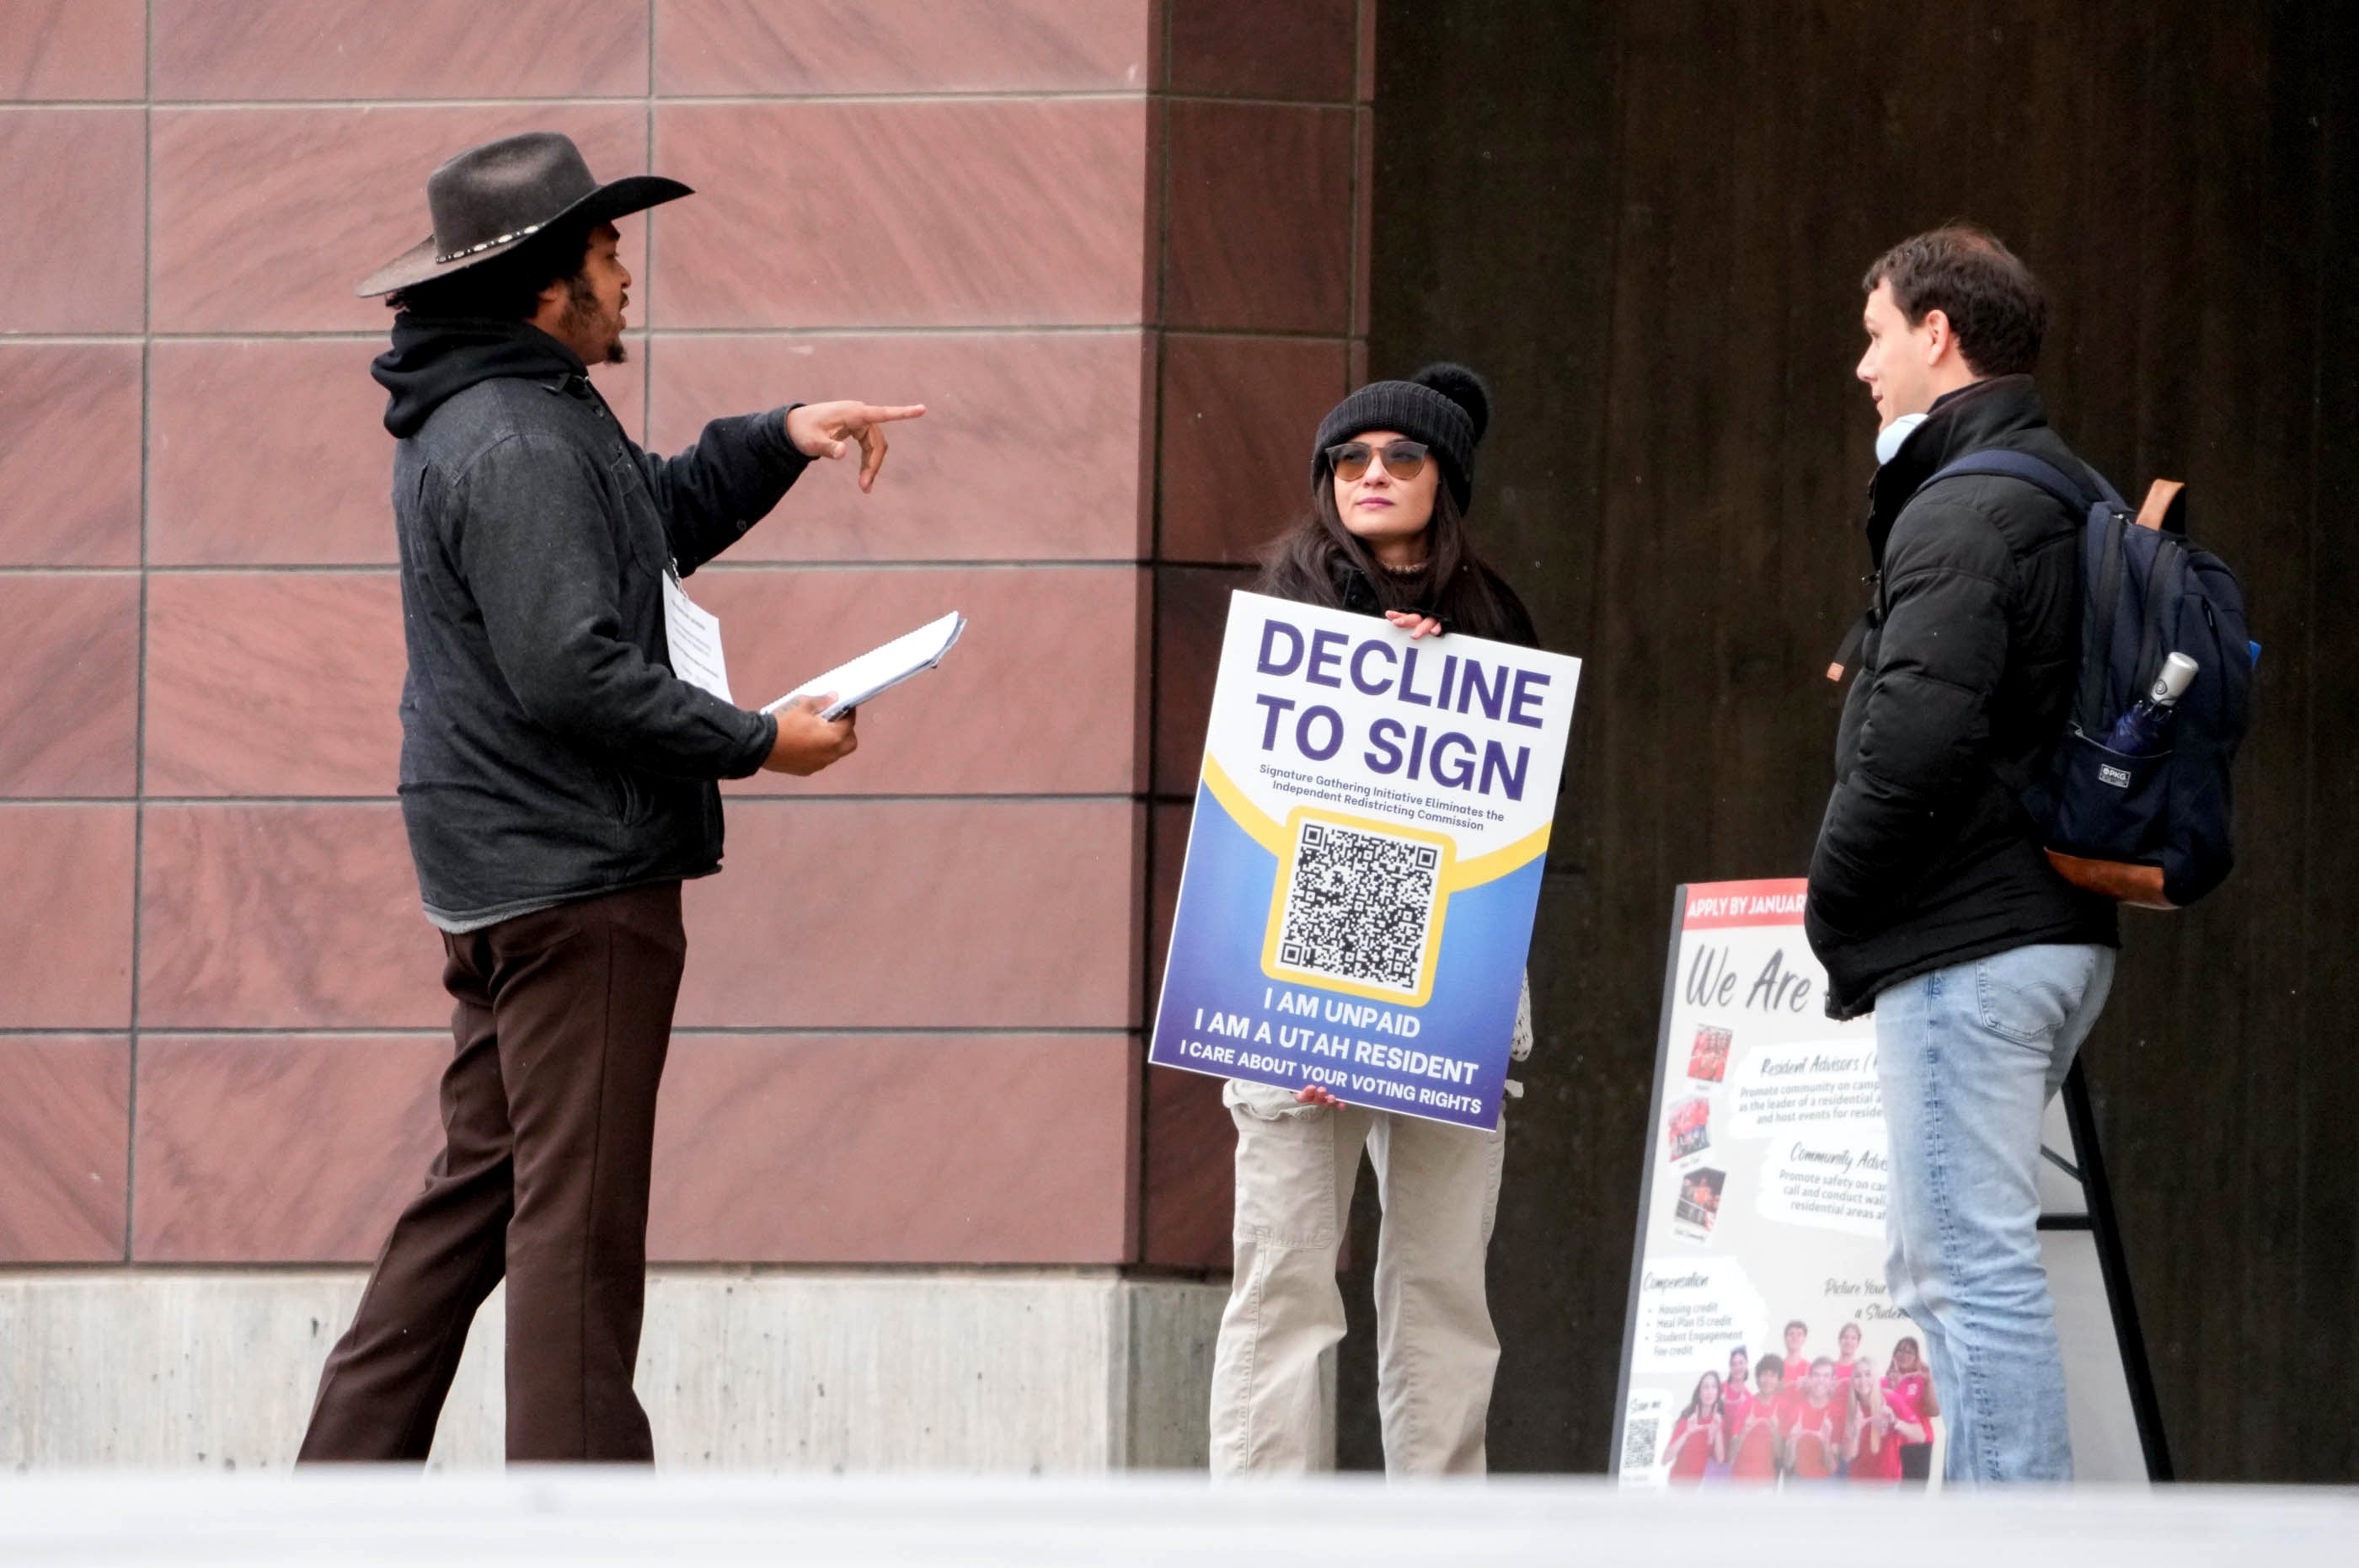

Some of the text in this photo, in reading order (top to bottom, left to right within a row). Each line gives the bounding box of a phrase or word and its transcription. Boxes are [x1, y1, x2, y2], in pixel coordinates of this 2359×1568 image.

[1256, 618, 1551, 730] DECLINE
[1255, 693, 1531, 801] TO SIGN
[1260, 764, 1505, 821] Signature Gathering Initiative Eliminates the
[1272, 779, 1484, 831] Independent Redistricting Commission
[1687, 893, 1808, 918] APPLY BY JANUAR
[1685, 944, 1811, 1013] We Are
[1264, 987, 1421, 1038] I AM UNPAID
[1195, 1008, 1479, 1085] I AM A UTAH RESIDENT
[1180, 1040, 1483, 1114] I CARE ABOUT YOUR VOTING RIGHTS
[1760, 1057, 1809, 1078] Resident
[1811, 1053, 1859, 1073] Advisors
[1740, 1085, 1779, 1099] Promote
[1779, 1080, 1835, 1095] community
[1837, 1082, 1850, 1091] on
[1739, 1102, 1748, 1112] as
[1750, 1099, 1765, 1110] the
[1767, 1097, 1796, 1110] leader
[1798, 1095, 1809, 1106] of
[1811, 1098, 1816, 1106] a
[1818, 1093, 1874, 1105] residential
[1757, 1111, 1773, 1125] and
[1775, 1110, 1797, 1122] host
[1799, 1110, 1832, 1121] events
[1833, 1106, 1848, 1119] for
[1790, 1140, 1854, 1174] Community
[1779, 1169, 1821, 1184] Promote
[1822, 1174, 1854, 1189] safety
[1855, 1179, 1869, 1189] on
[1784, 1183, 1800, 1196] call
[1801, 1185, 1820, 1197] and
[1821, 1189, 1863, 1203] conduct
[1790, 1200, 1844, 1215] residential
[1846, 1206, 1874, 1219] areas
[1643, 1271, 1709, 1294] Compensation
[1824, 1277, 1861, 1296] Picture
[1692, 1301, 1719, 1314] credit
[1706, 1314, 1733, 1326] credit
